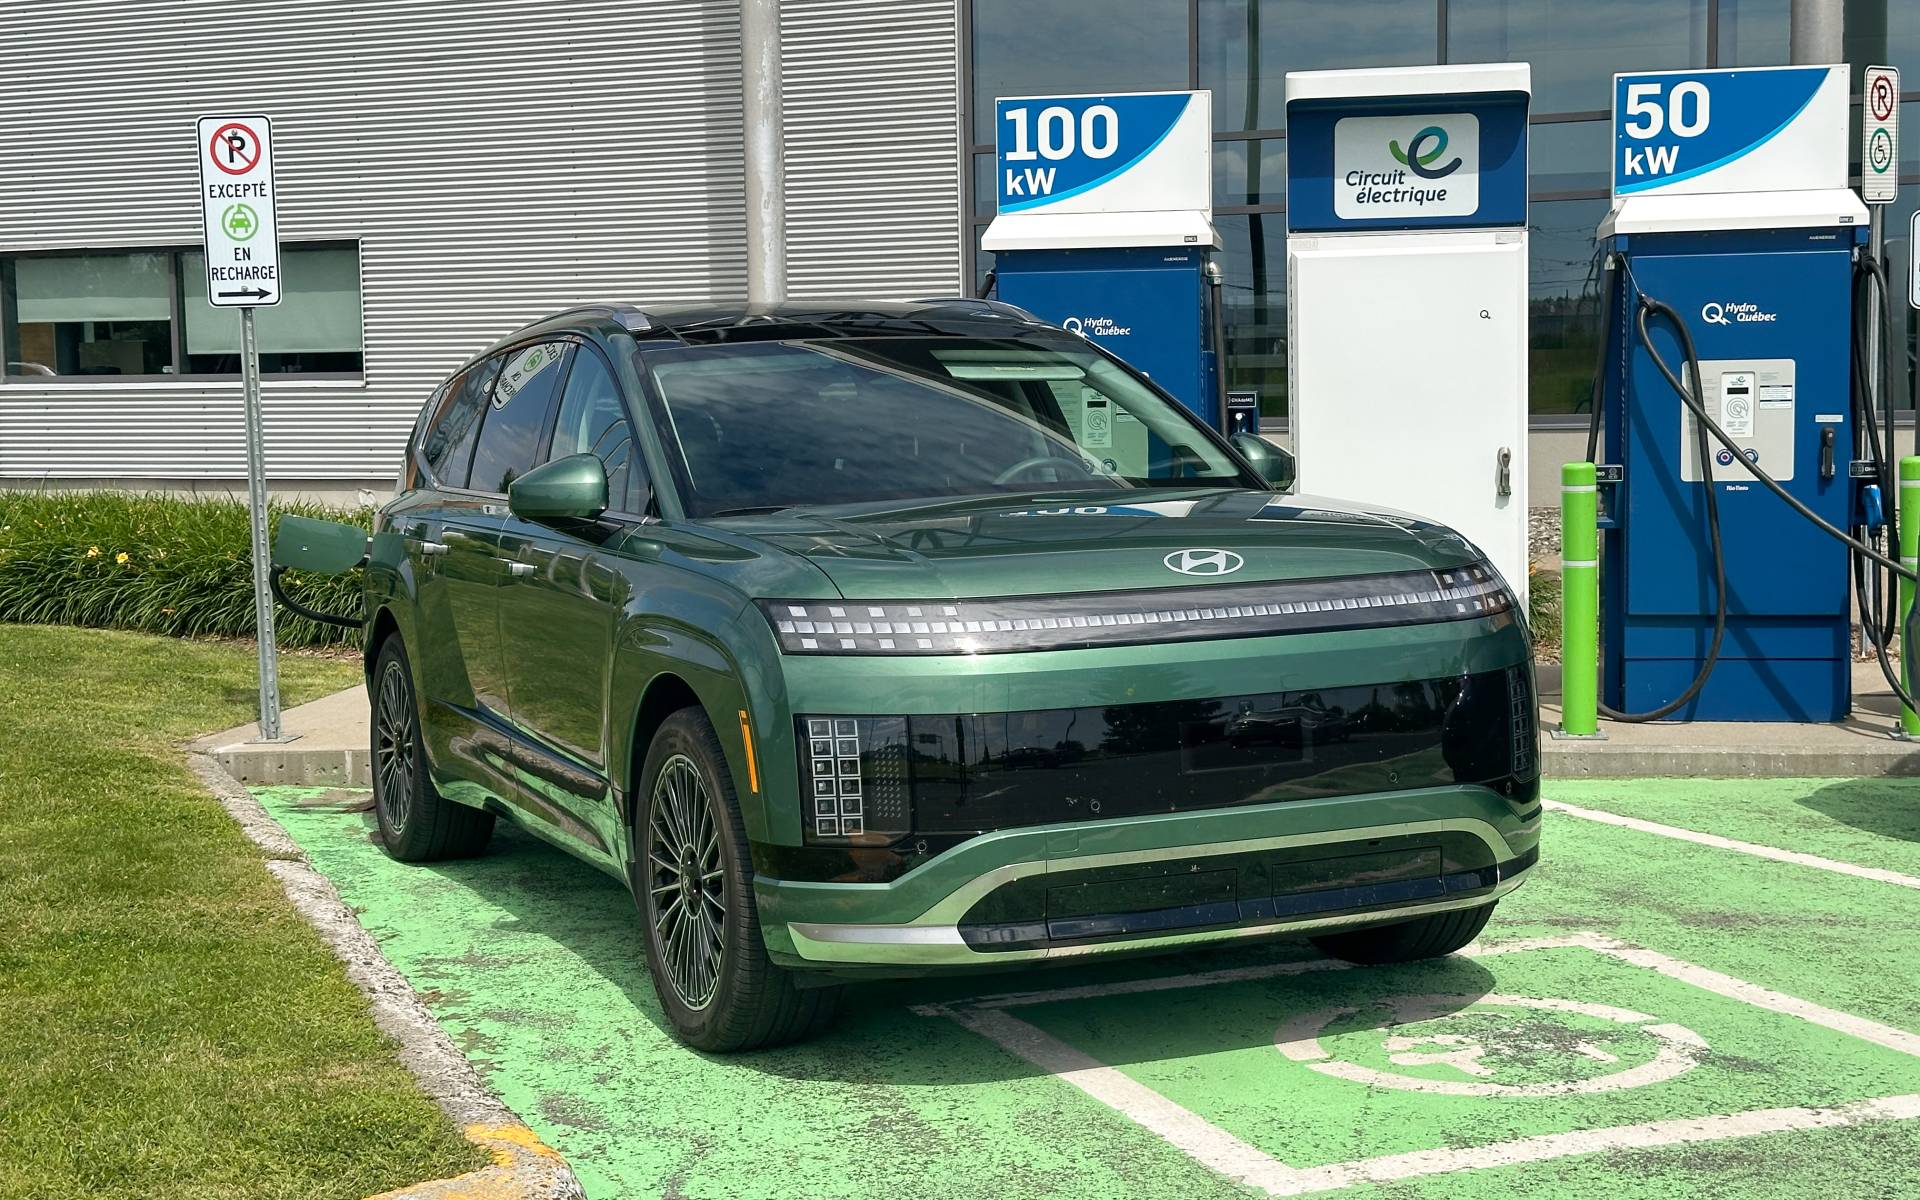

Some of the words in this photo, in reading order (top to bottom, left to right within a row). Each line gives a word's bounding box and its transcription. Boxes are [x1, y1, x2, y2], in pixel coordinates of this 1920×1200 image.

[1624, 81, 1711, 140] 50
[1005, 104, 1119, 161] 100
[227, 136, 246, 163] P
[1623, 145, 1680, 176] kW
[1006, 167, 1057, 196] kW
[1345, 169, 1406, 187] Circuit
[209, 181, 268, 199] EXCEPTÉ
[1355, 186, 1448, 206] électrique
[234, 247, 251, 261] EN
[211, 265, 276, 281] RECHARGE
[1725, 302, 1757, 314] Hydro
[1736, 312, 1777, 322] Québec
[1084, 317, 1113, 329] Hydro
[1094, 326, 1131, 336] Québec
